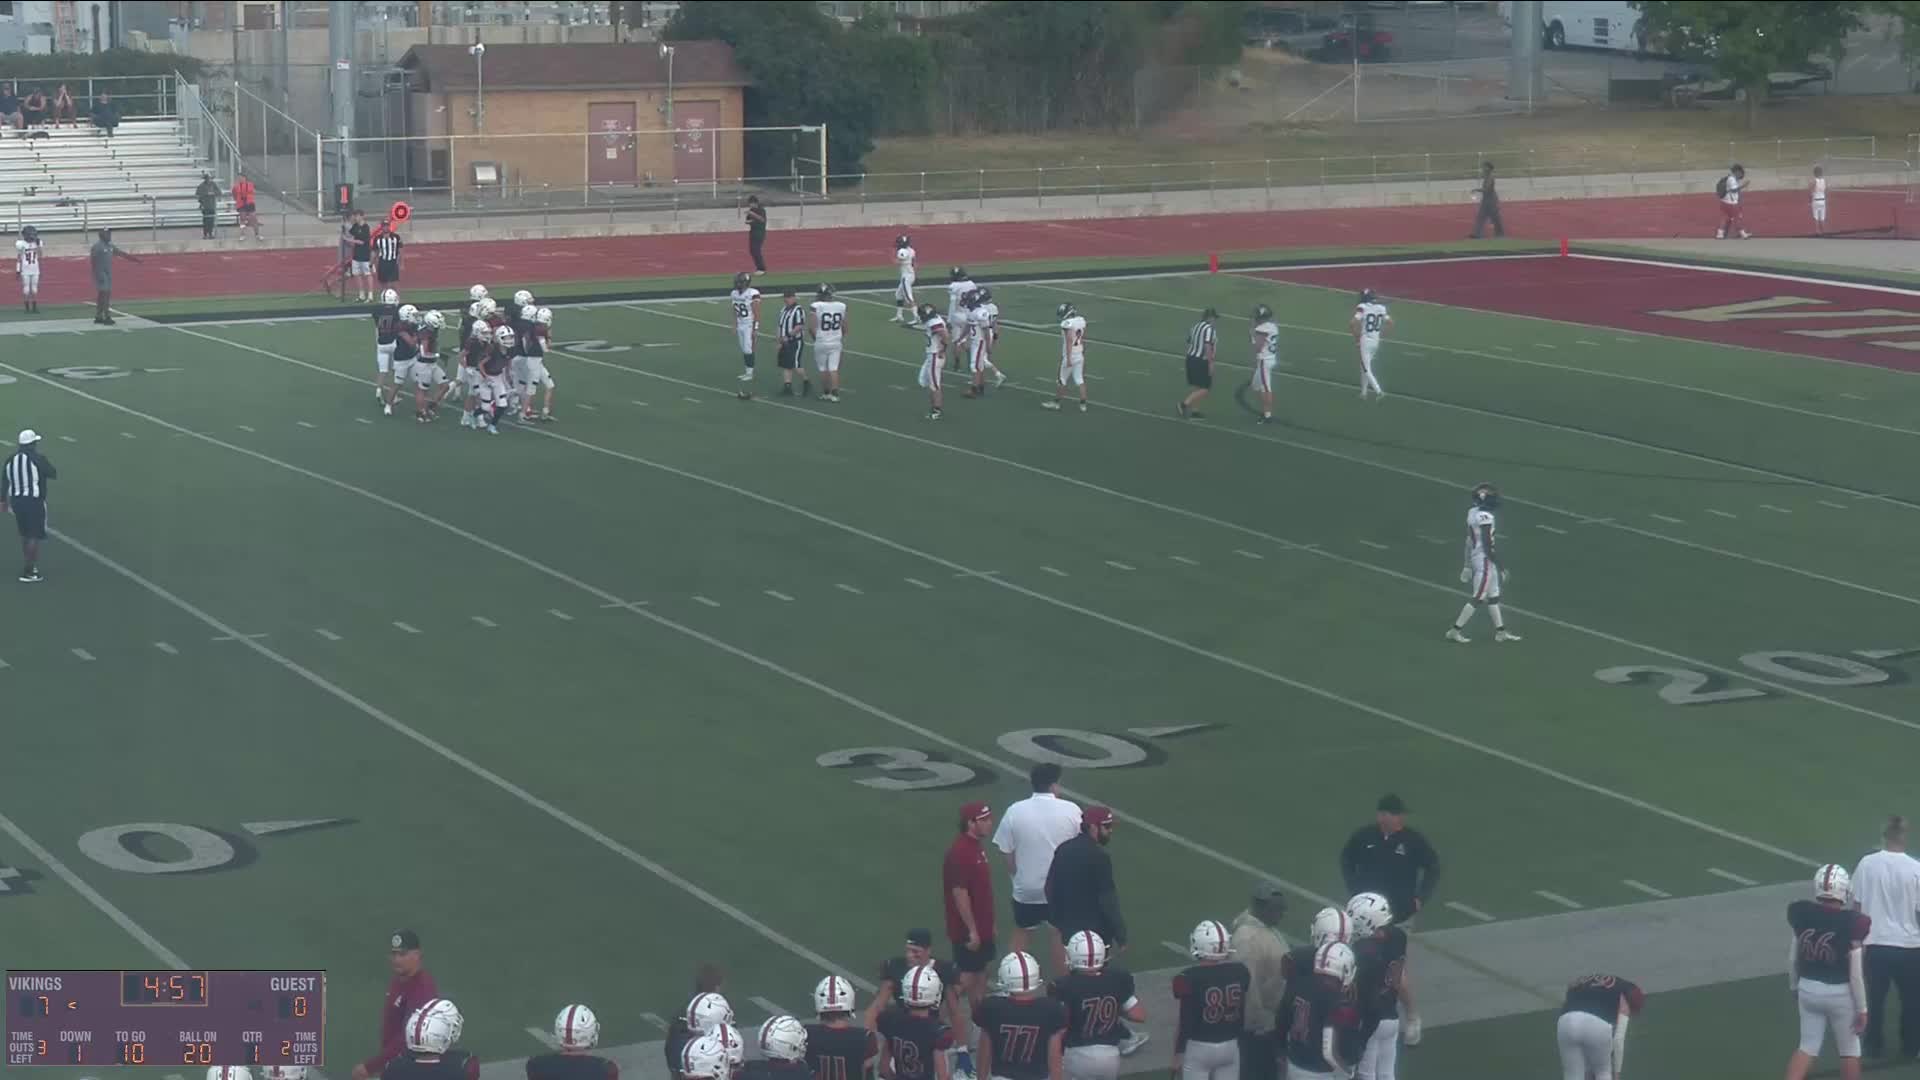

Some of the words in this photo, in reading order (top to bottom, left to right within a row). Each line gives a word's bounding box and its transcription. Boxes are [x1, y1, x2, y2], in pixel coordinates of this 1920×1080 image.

[819, 312, 843, 331] 68
[1366, 313, 1384, 332] 80
[1593, 650, 1889, 705] 20
[816, 727, 1147, 791] 30
[1083, 995, 1119, 1038] 79
[1202, 982, 1242, 1025] 85
[1000, 1024, 1040, 1063] 77
